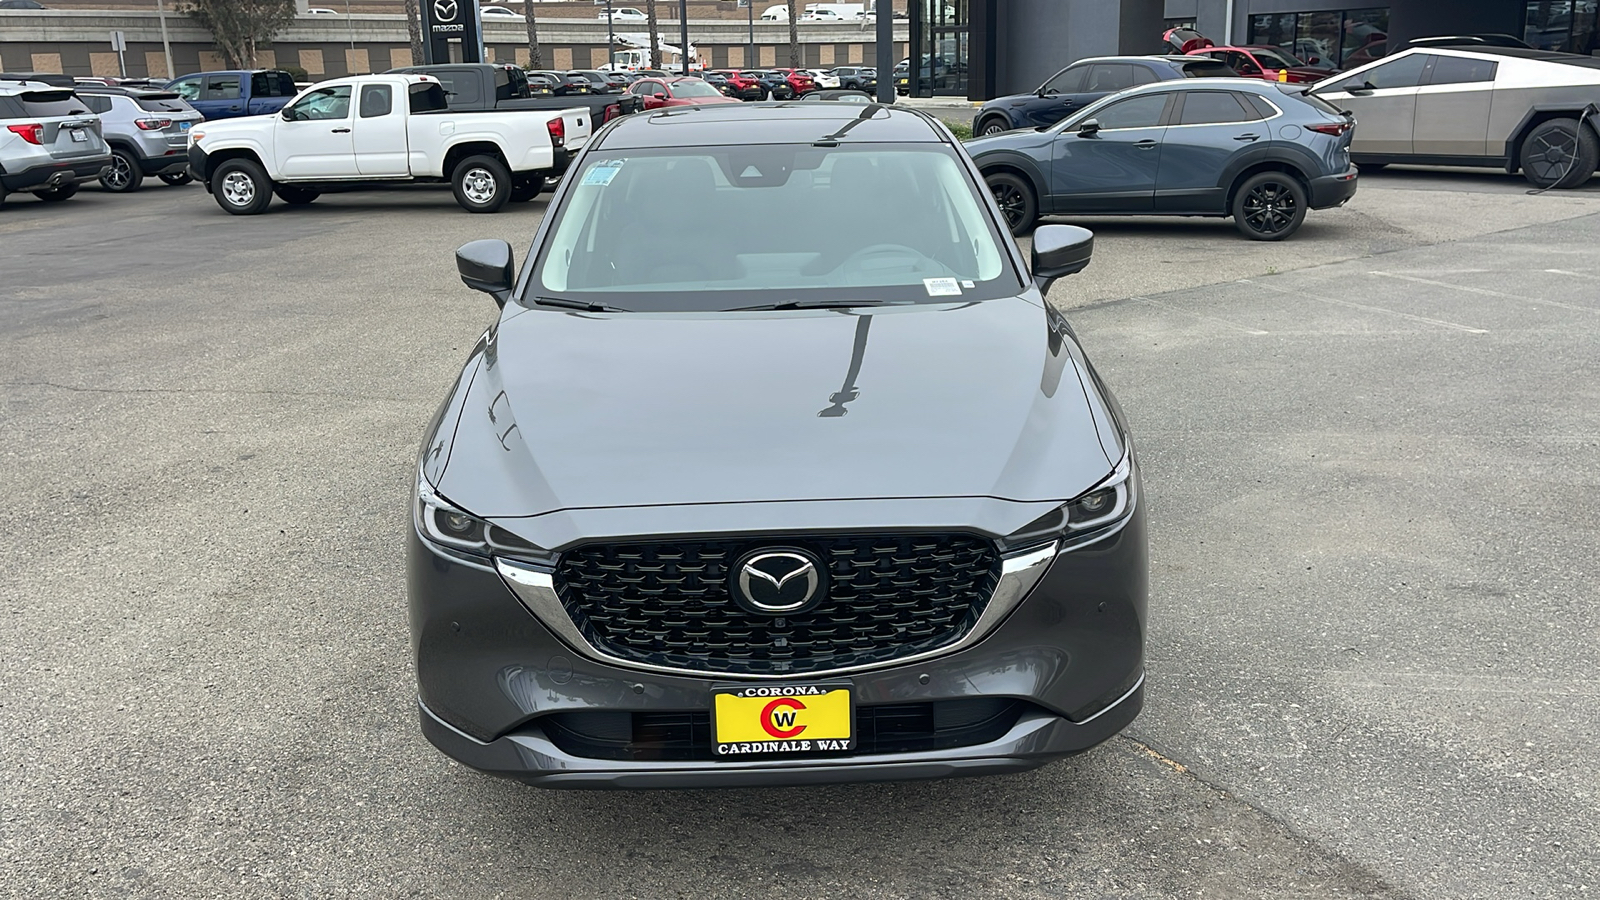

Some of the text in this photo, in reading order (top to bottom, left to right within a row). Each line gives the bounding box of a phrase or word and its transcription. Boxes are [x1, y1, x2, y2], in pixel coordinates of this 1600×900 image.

[745, 686, 820, 697] CORONA
[718, 739, 850, 755] CARDINALE WAY
